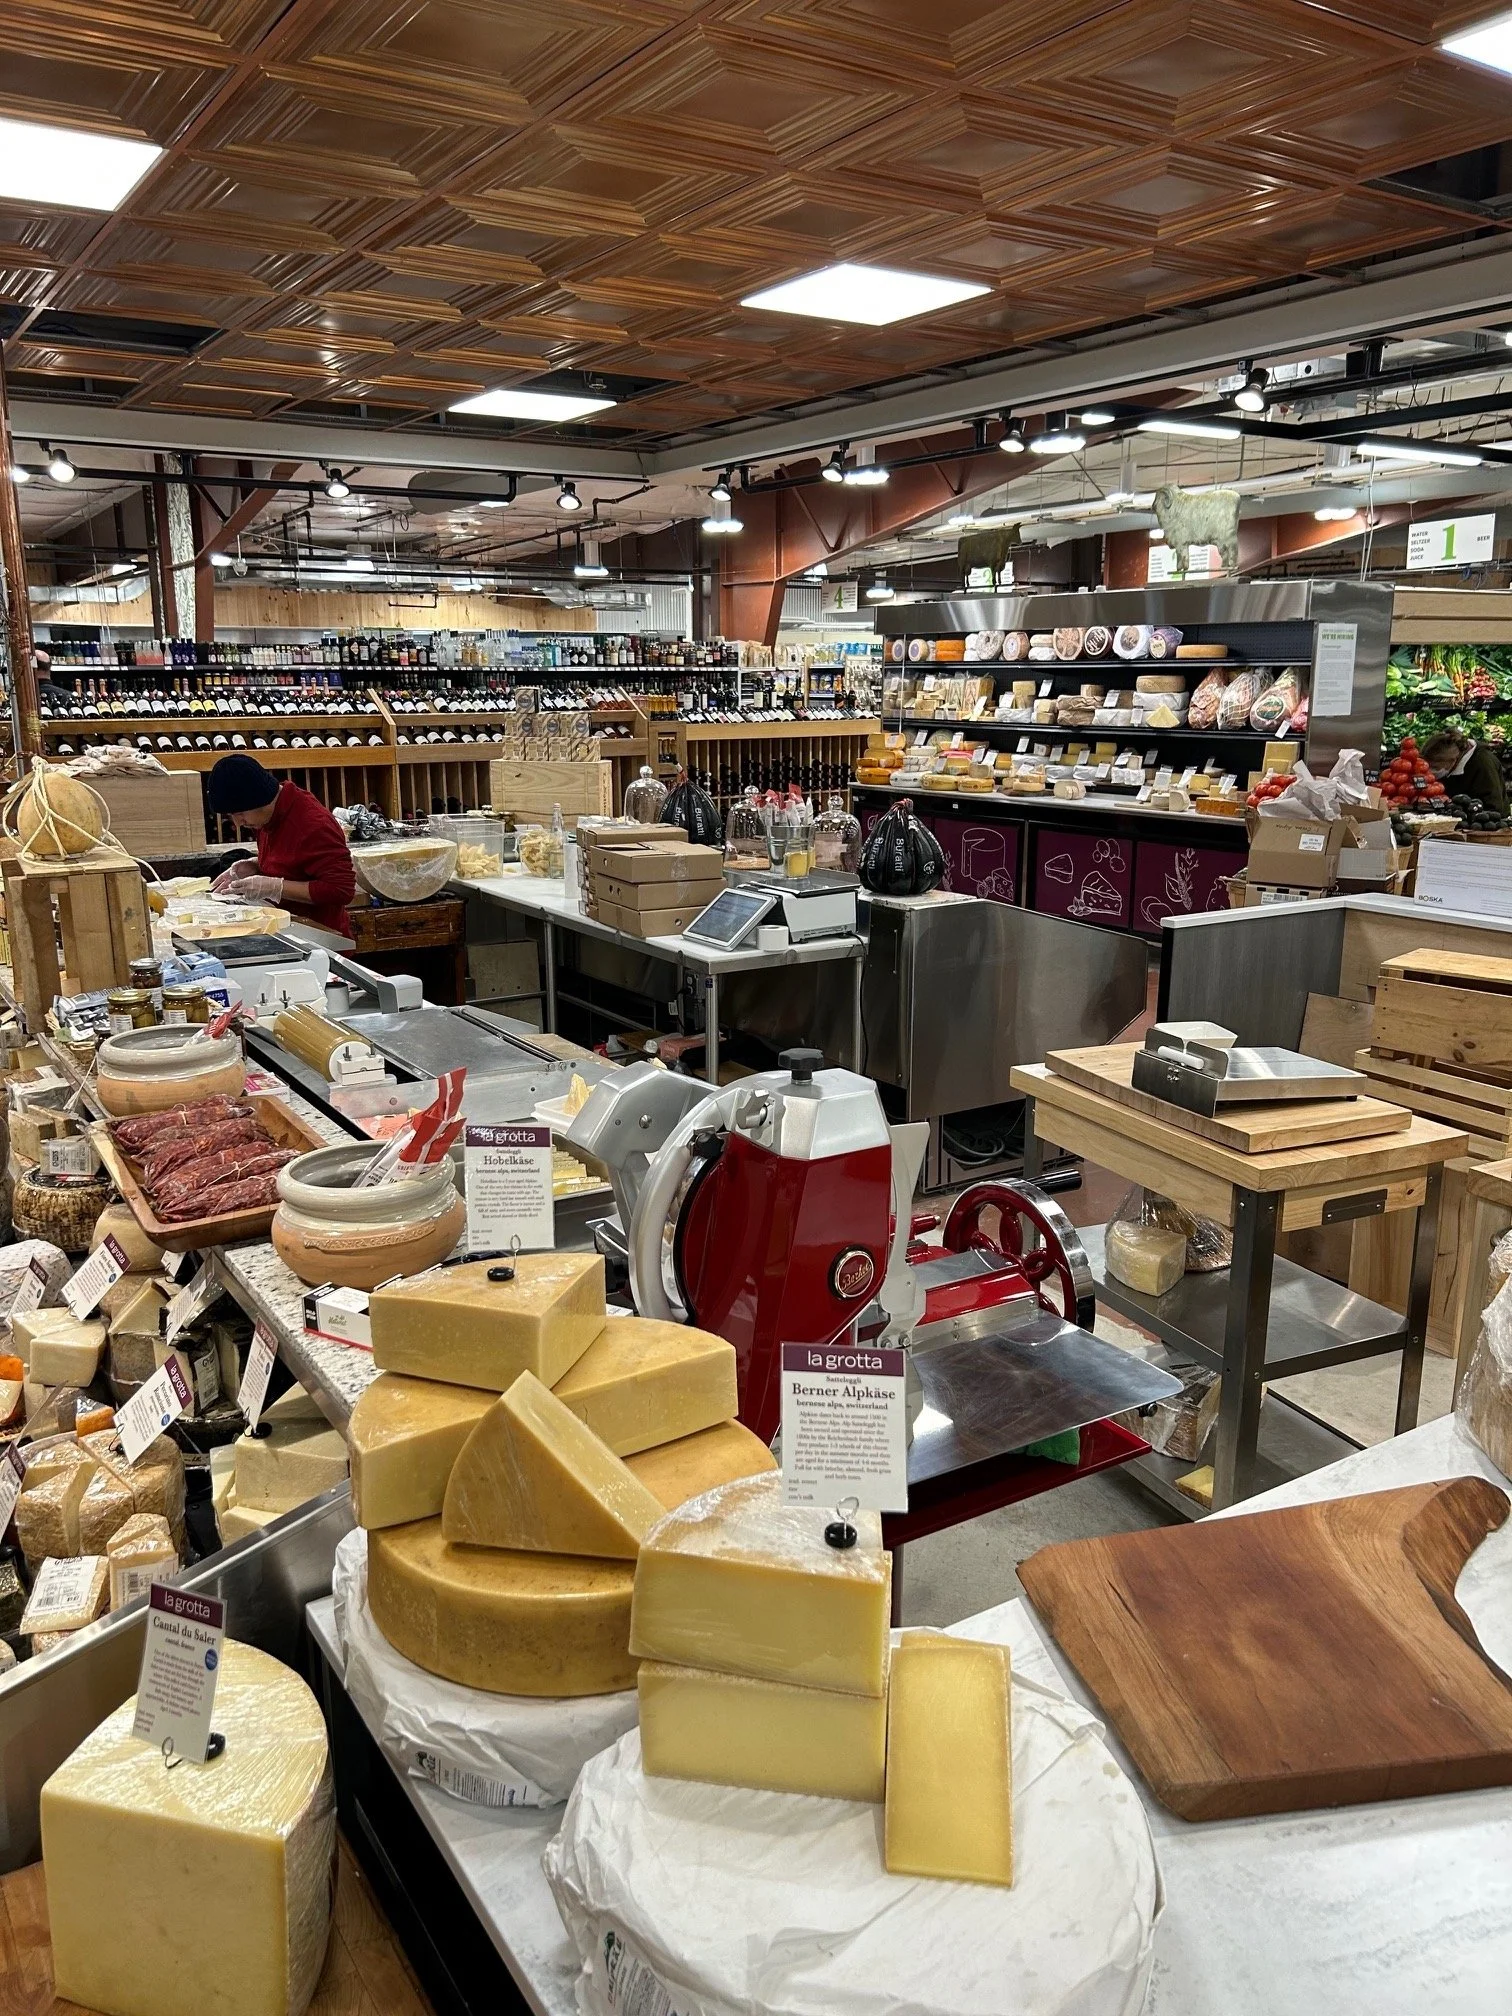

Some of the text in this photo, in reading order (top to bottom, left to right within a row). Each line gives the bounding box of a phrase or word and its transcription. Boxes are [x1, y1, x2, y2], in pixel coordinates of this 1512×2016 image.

[1410, 538, 1430, 546] SELTZER
[1411, 530, 1428, 538] WATER
[1441, 523, 1457, 561] 1
[1476, 534, 1491, 542] BEER
[834, 585, 844, 609] 4
[1418, 894, 1443, 903] BOSKA
[495, 1130, 536, 1144] grotta
[483, 1155, 535, 1165] Hobelkäse
[808, 1350, 883, 1370] la grotta
[170, 1364, 188, 1399] la grotta
[792, 1383, 896, 1401] Berner Alpkäse
[796, 1399, 888, 1410] bernese alps, switzerland
[164, 1590, 211, 1618] la grotta
[153, 1615, 217, 1645] Cantal du Saler
